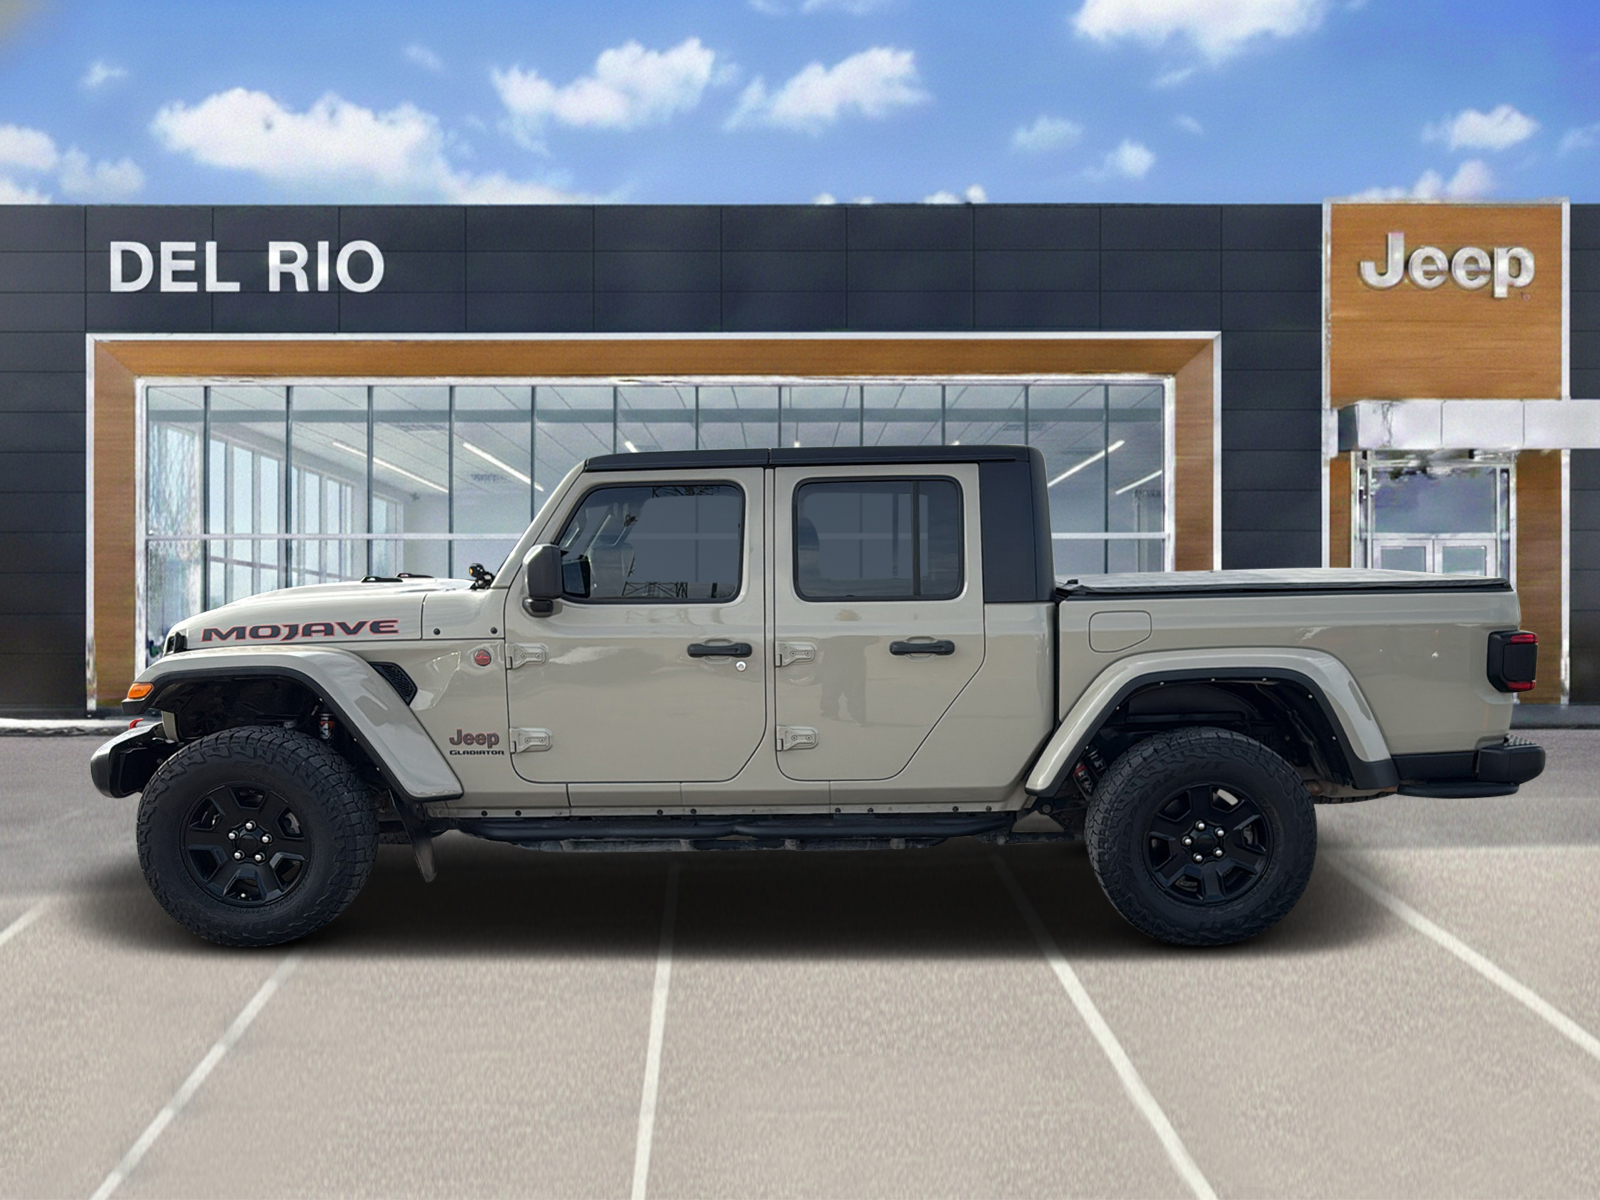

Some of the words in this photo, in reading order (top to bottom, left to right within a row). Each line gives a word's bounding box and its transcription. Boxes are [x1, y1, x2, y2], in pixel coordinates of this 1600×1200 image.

[110, 240, 241, 292] DEL
[268, 239, 385, 293] RIO
[1359, 231, 1536, 299] Jeep
[201, 619, 399, 642] MOJAVE
[448, 729, 500, 749] Jeep
